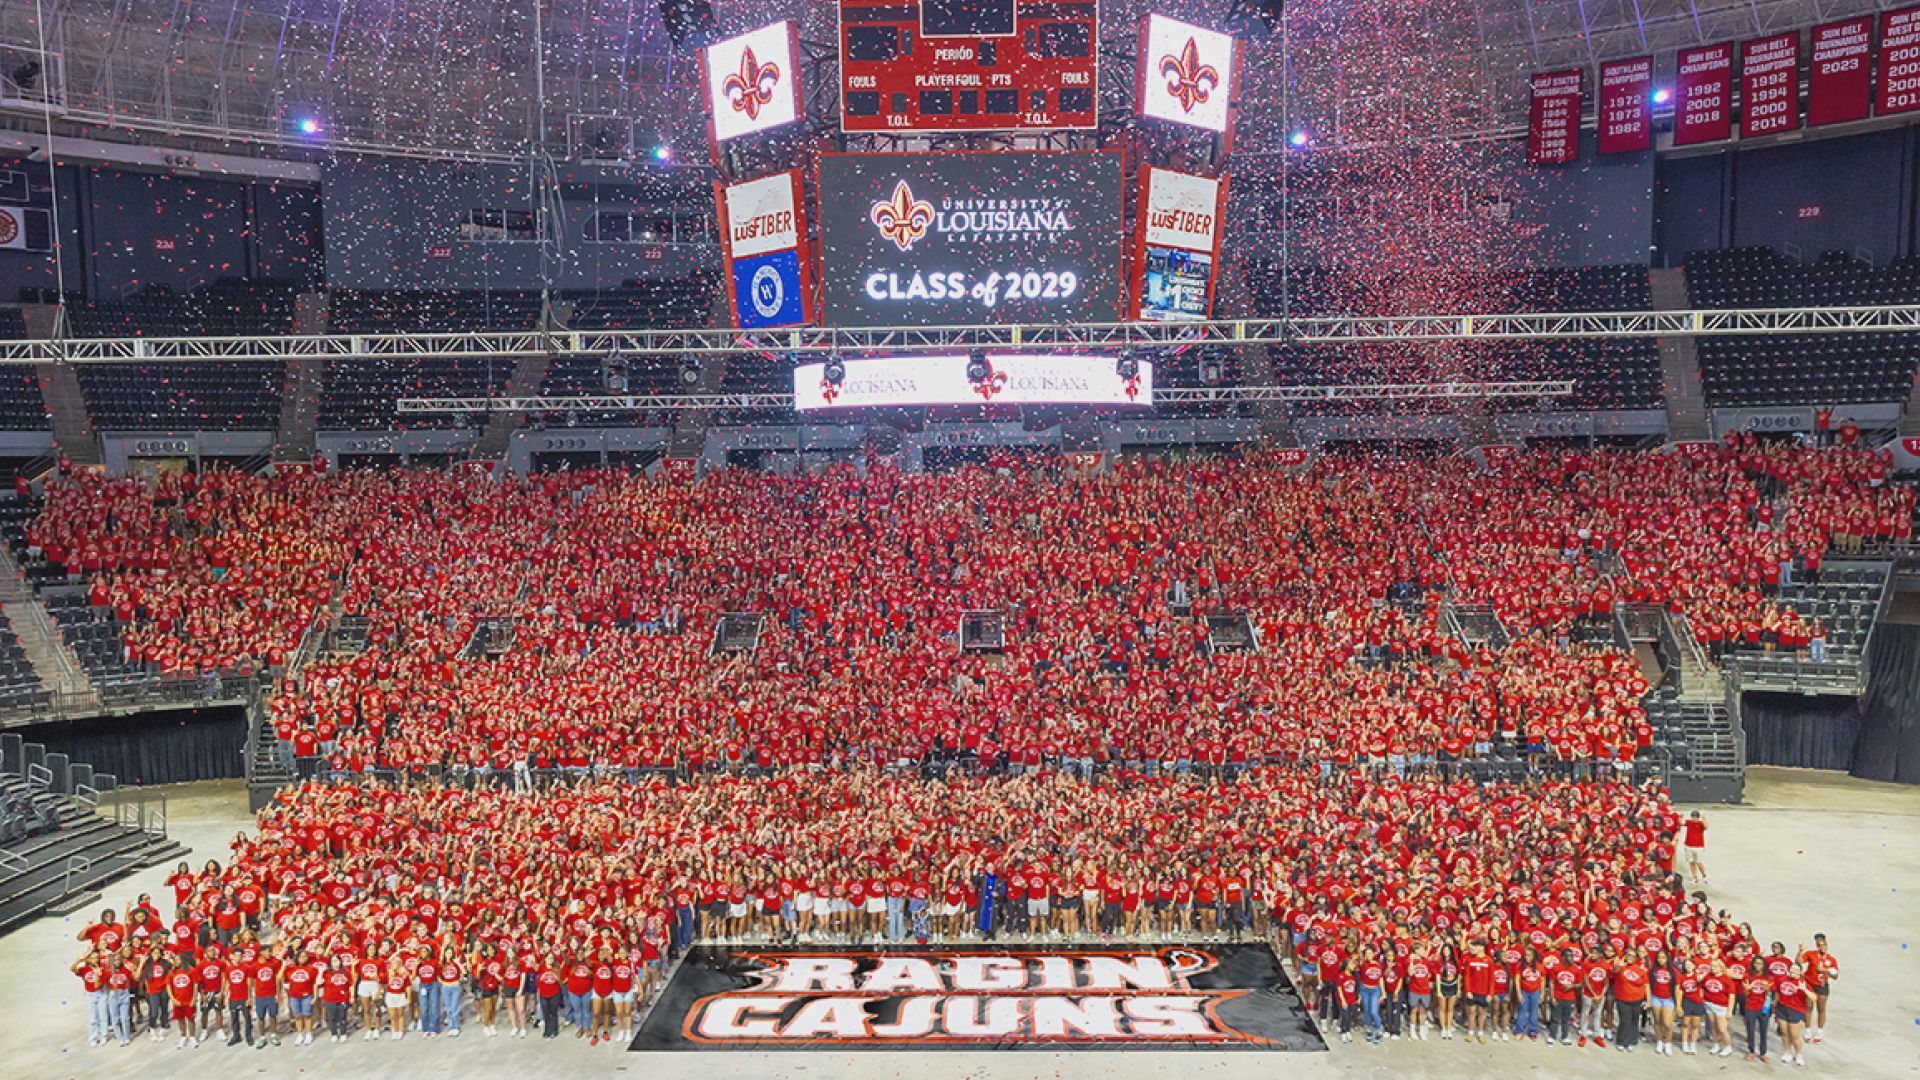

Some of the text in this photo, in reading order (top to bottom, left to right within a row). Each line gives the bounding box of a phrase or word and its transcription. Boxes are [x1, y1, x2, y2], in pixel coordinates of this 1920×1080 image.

[1841, 23, 1862, 36] BELT
[1769, 38, 1789, 50] BELT
[1815, 33, 1868, 50] TOURNAMENT
[934, 48, 973, 60] PERIOD
[1705, 49, 1724, 61] BELT
[1744, 47, 1795, 65] TOURNAMENT
[1814, 43, 1868, 61] CHAMPIONS
[1889, 47, 1920, 61] 200
[1680, 57, 1729, 74] CHAMPIONS
[1744, 57, 1796, 76] CHAMPIONS
[1822, 58, 1859, 74] 2023
[1888, 62, 1920, 77] 200
[848, 76, 877, 87] FOULS
[915, 74, 1012, 86] PLAYER FOUL PTS
[1061, 73, 1089, 84] FOULS
[1603, 72, 1649, 86] CHAMPIONS
[1751, 72, 1787, 88] 1992
[1687, 82, 1721, 97] 1992
[1751, 87, 1787, 103] 1994
[1609, 95, 1641, 108] 1972
[1686, 96, 1720, 111] 2000
[1887, 93, 1920, 108] 201
[1609, 109, 1641, 122] 1973
[1751, 101, 1787, 117] 2000
[1686, 111, 1720, 124] 2018
[1751, 115, 1787, 131] 2014
[1608, 122, 1641, 135] 1982
[942, 199, 1049, 210] UNIVERSITY
[936, 211, 1073, 232] LOUISIANA
[866, 271, 1077, 307] CLASS of 2029
[1010, 376, 1089, 391] LOUISIANA
[699, 996, 1226, 1038] CAJUNS
